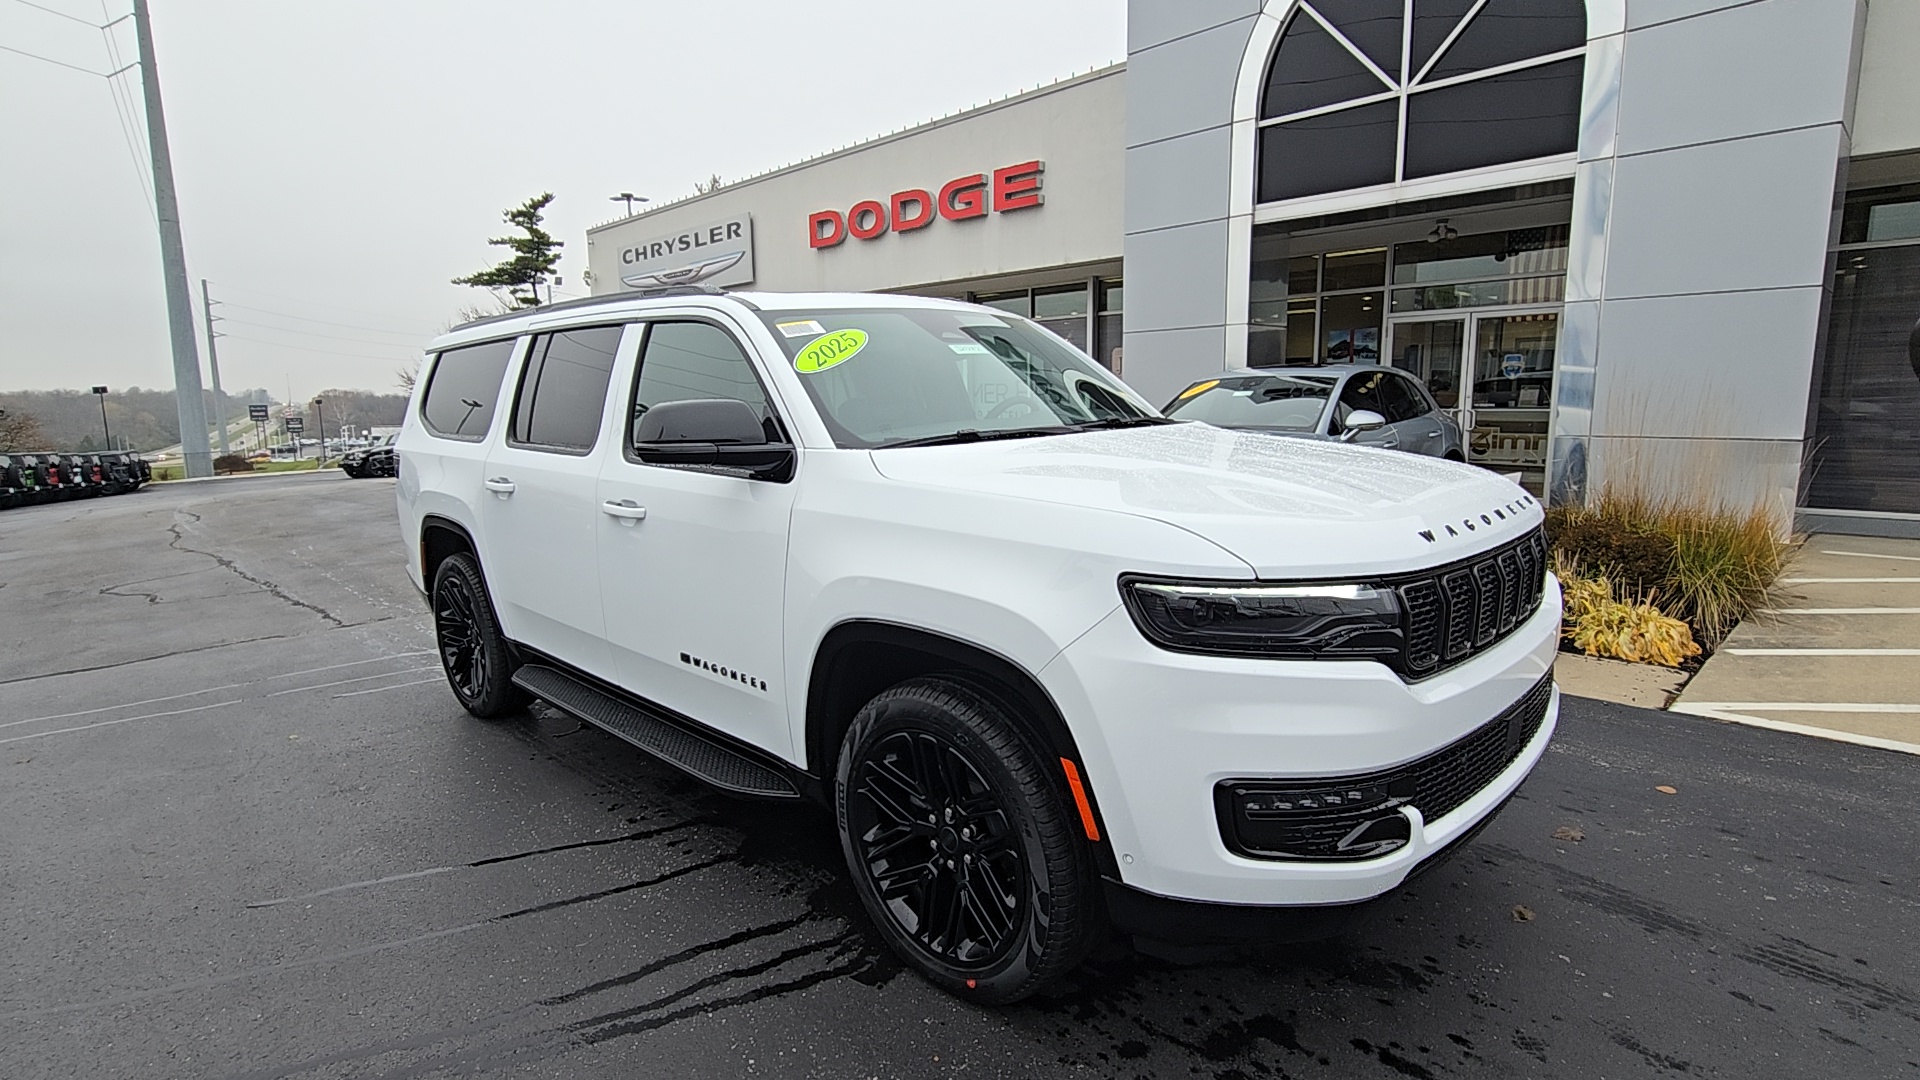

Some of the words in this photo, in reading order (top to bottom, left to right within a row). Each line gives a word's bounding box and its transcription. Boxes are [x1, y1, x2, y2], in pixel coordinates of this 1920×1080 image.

[809, 160, 1044, 249] DODGE
[622, 222, 742, 264] CHRYSLER
[807, 333, 858, 368] 2025
[1417, 495, 1534, 543] WAGONEER
[692, 656, 768, 692] WAGONEER
